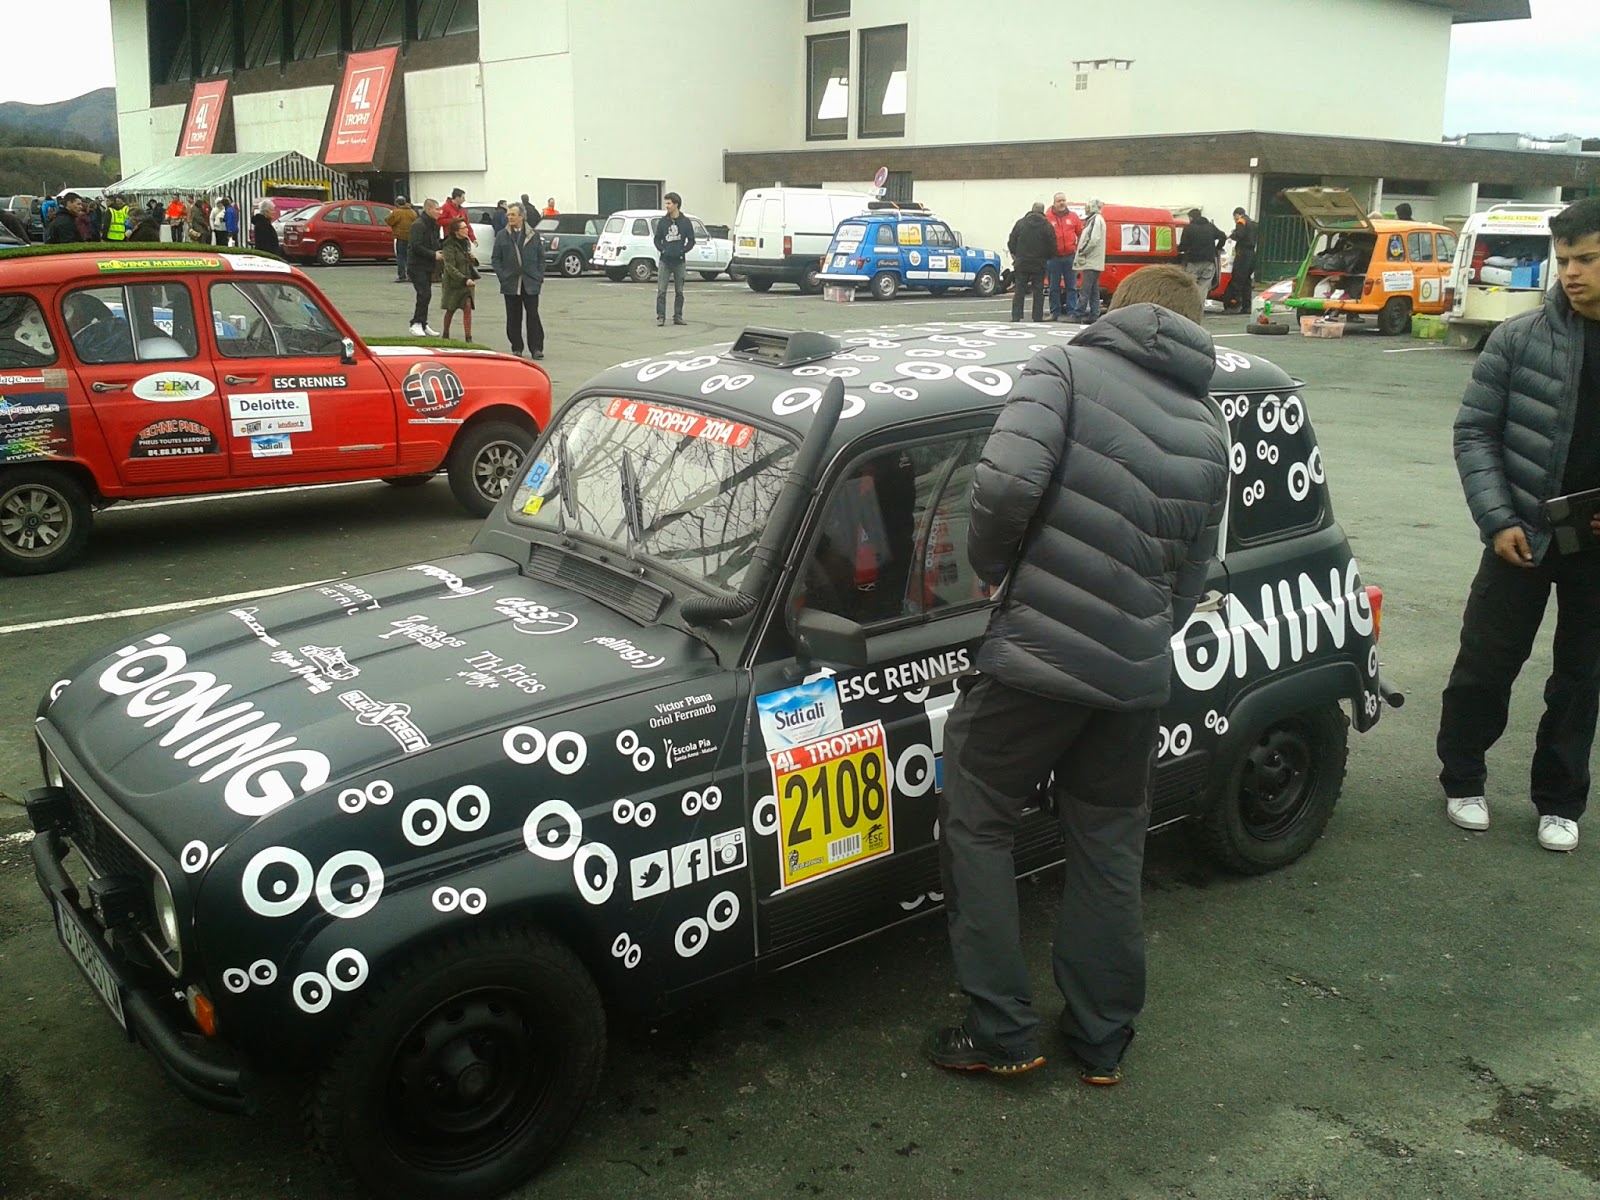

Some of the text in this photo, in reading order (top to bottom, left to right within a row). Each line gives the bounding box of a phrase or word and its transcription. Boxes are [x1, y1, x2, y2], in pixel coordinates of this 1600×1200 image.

[351, 77, 371, 110] 4L
[195, 103, 209, 130] 4L
[344, 112, 371, 126] TROPHY
[0, 377, 22, 385] age
[274, 375, 346, 389] ESC RENNES
[139, 420, 211, 440] TECHNIC PNEUS
[622, 403, 734, 443] 4L TROPHY 2014
[1170, 557, 1373, 691] ONING
[838, 648, 972, 704] ESC RENNES
[684, 693, 713, 706] Plana
[649, 703, 717, 729] Oriol Ferrando
[774, 701, 826, 731] Sidi ali
[672, 738, 711, 755] Escola Pia
[775, 751, 802, 773] 4L
[806, 725, 880, 761] TROPHY
[784, 751, 886, 848] 2108
